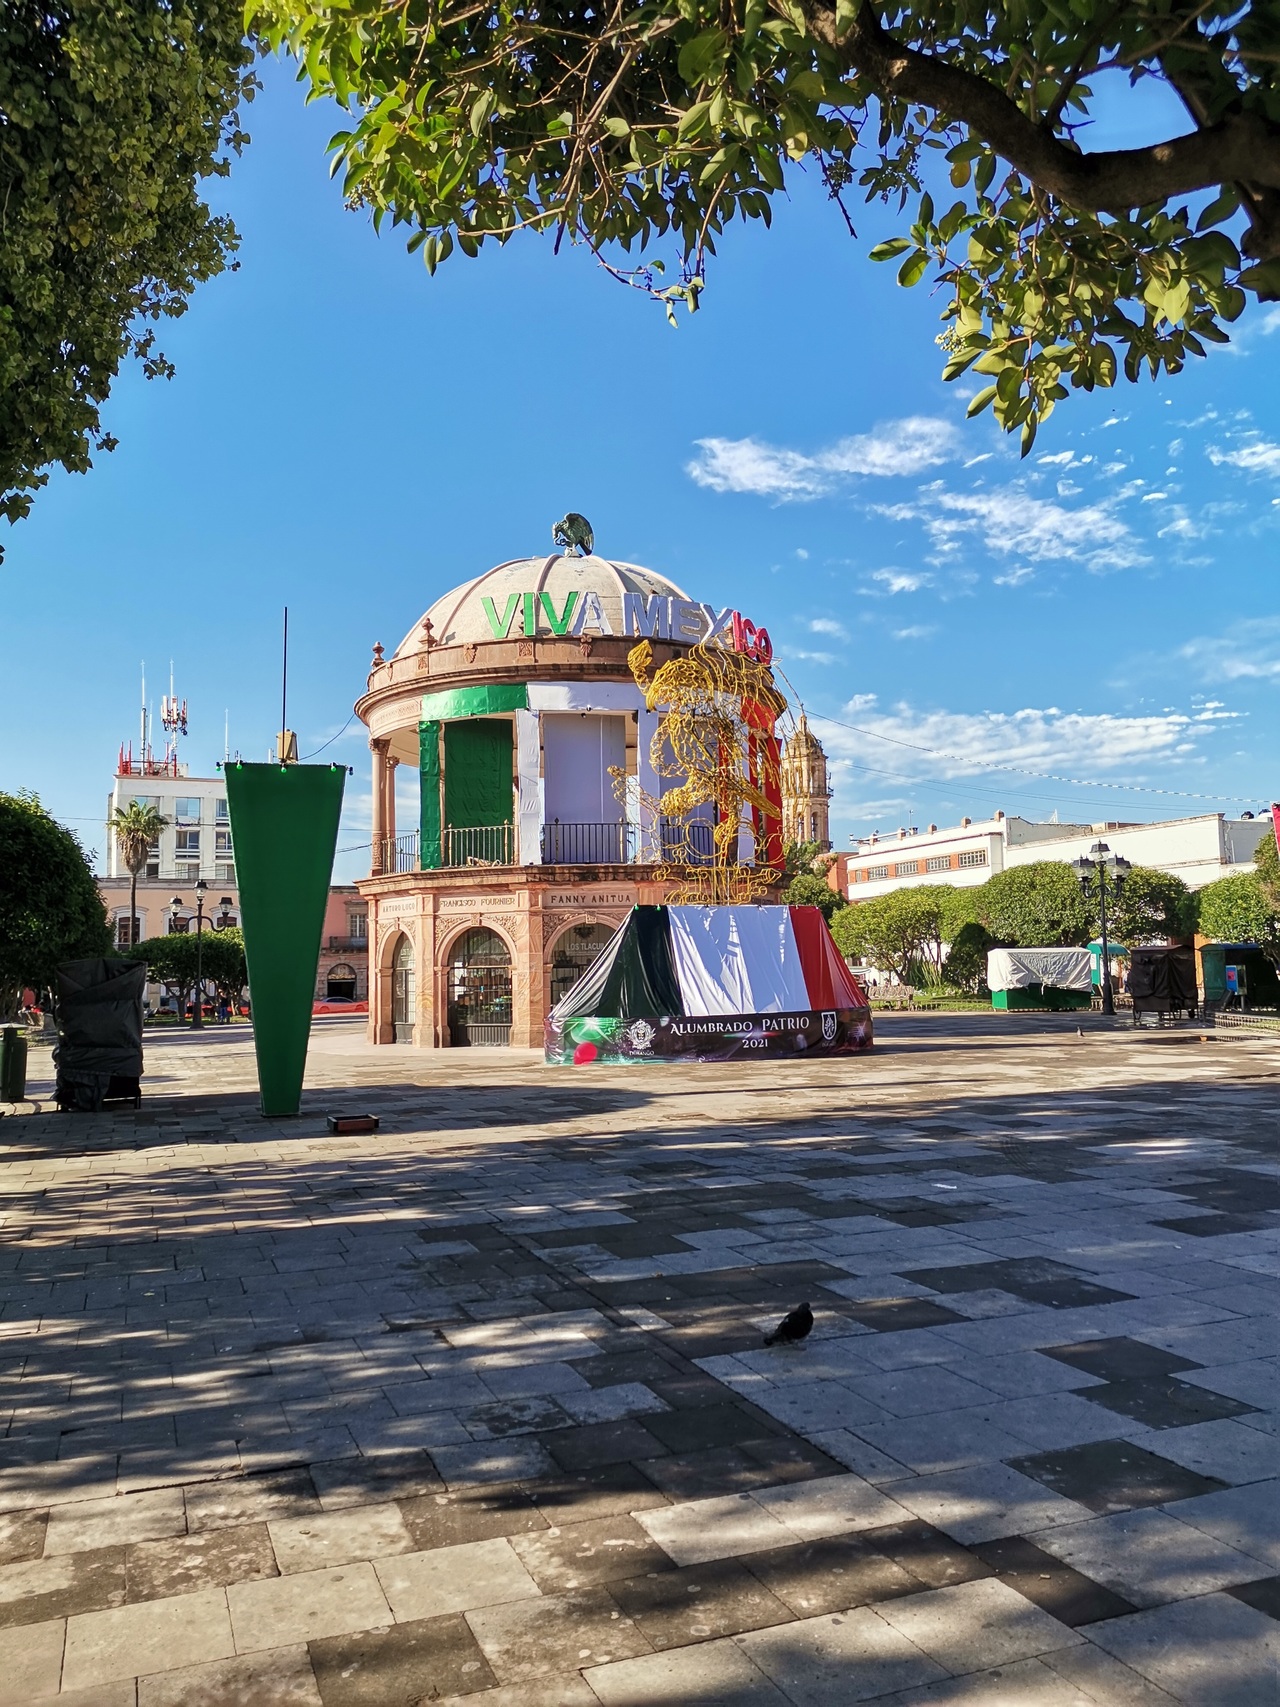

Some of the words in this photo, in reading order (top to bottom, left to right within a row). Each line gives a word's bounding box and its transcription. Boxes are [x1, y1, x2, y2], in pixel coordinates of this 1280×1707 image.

[481, 591, 614, 639] VIVA
[621, 592, 774, 666] MEXICO
[440, 898, 477, 908] FRANCISCO
[480, 897, 516, 906] FOURNIER
[551, 895, 587, 904] FANNY
[591, 894, 631, 903] ANITUA
[566, 942, 580, 952] LOS
[670, 1020, 753, 1035] ALUMBRADO
[762, 1016, 810, 1031] PATRIO
[742, 1038, 768, 1048] 2021
